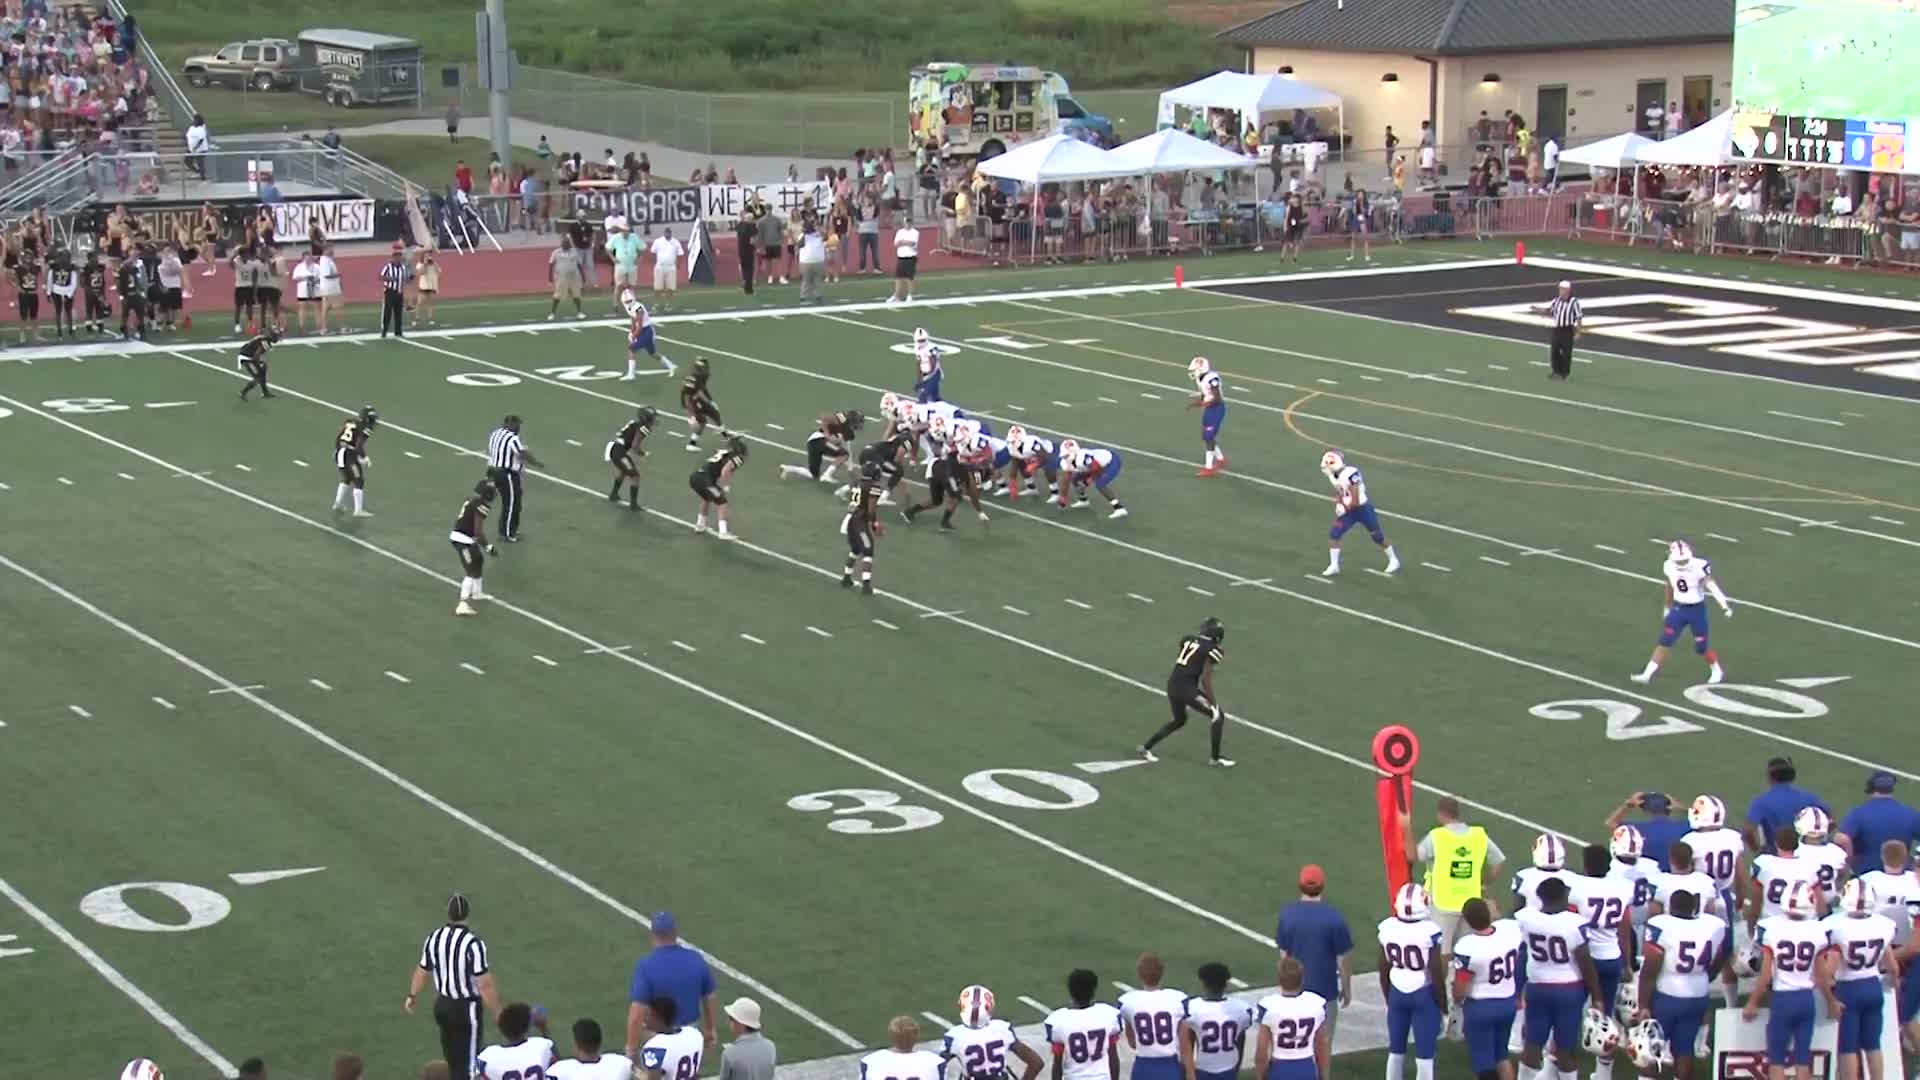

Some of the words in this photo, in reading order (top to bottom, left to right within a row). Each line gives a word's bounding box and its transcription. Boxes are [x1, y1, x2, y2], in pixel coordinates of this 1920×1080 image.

[274, 202, 372, 237] ORTHWEST
[1677, 578, 1689, 593] 8
[1176, 640, 1200, 666] 17
[1705, 849, 1734, 878] 10
[1588, 897, 1622, 930] 72
[1386, 942, 1425, 972] 80
[1529, 933, 1570, 964] 50
[1675, 940, 1713, 974] 54
[1777, 939, 1816, 972] 29
[1847, 938, 1884, 971] 57
[1488, 948, 1518, 985] 60
[1134, 1011, 1173, 1046] 88
[1201, 1020, 1239, 1054] 20
[1277, 1017, 1315, 1049] 27
[964, 1039, 1005, 1076] 25
[1068, 1028, 1106, 1064] 87
